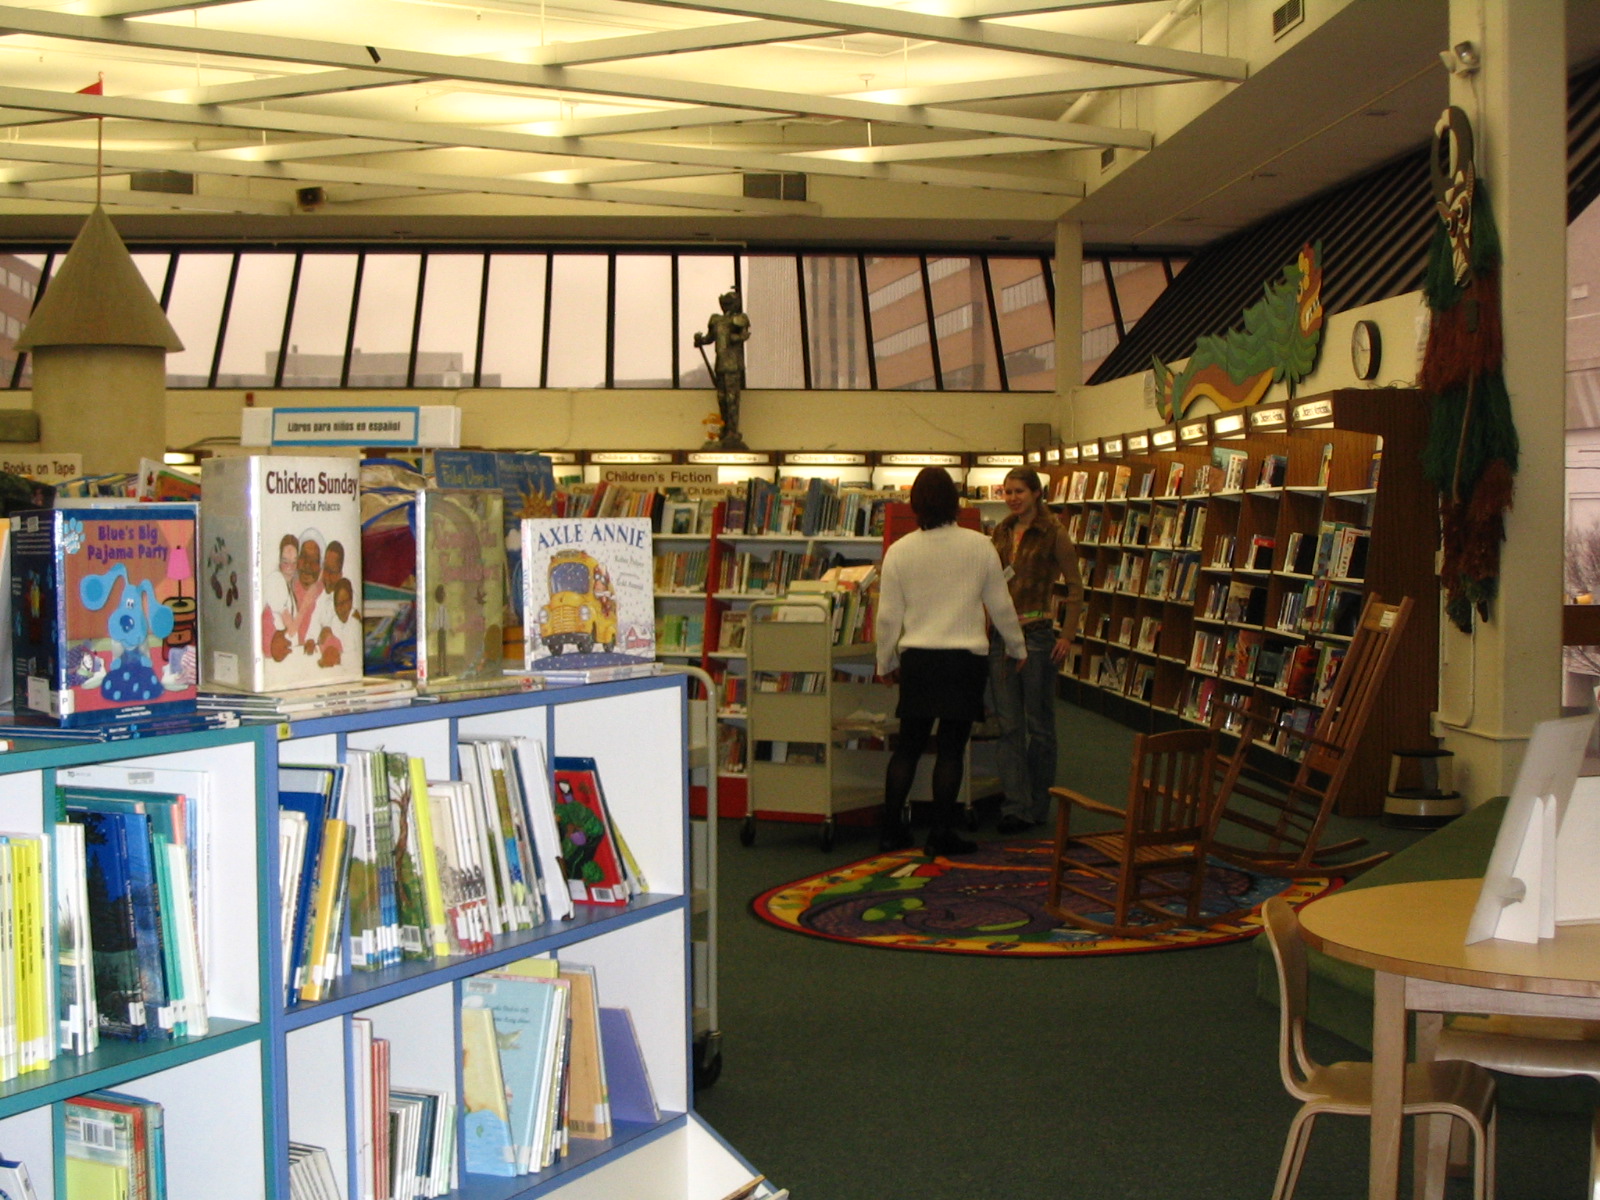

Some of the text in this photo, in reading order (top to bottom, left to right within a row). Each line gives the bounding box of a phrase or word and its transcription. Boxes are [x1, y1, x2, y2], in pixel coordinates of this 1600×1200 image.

[287, 421, 311, 432] Libros
[313, 422, 331, 433] para
[356, 422, 366, 431] en
[368, 420, 401, 433] español
[36, 463, 49, 475] on
[52, 460, 76, 478] Tape
[605, 470, 712, 483] Children's Fiction
[266, 470, 358, 501] Chicken Sunday
[98, 525, 135, 541] Blue's
[537, 523, 646, 551] AXLE ANNIE
[87, 544, 168, 564] Pajama Party
